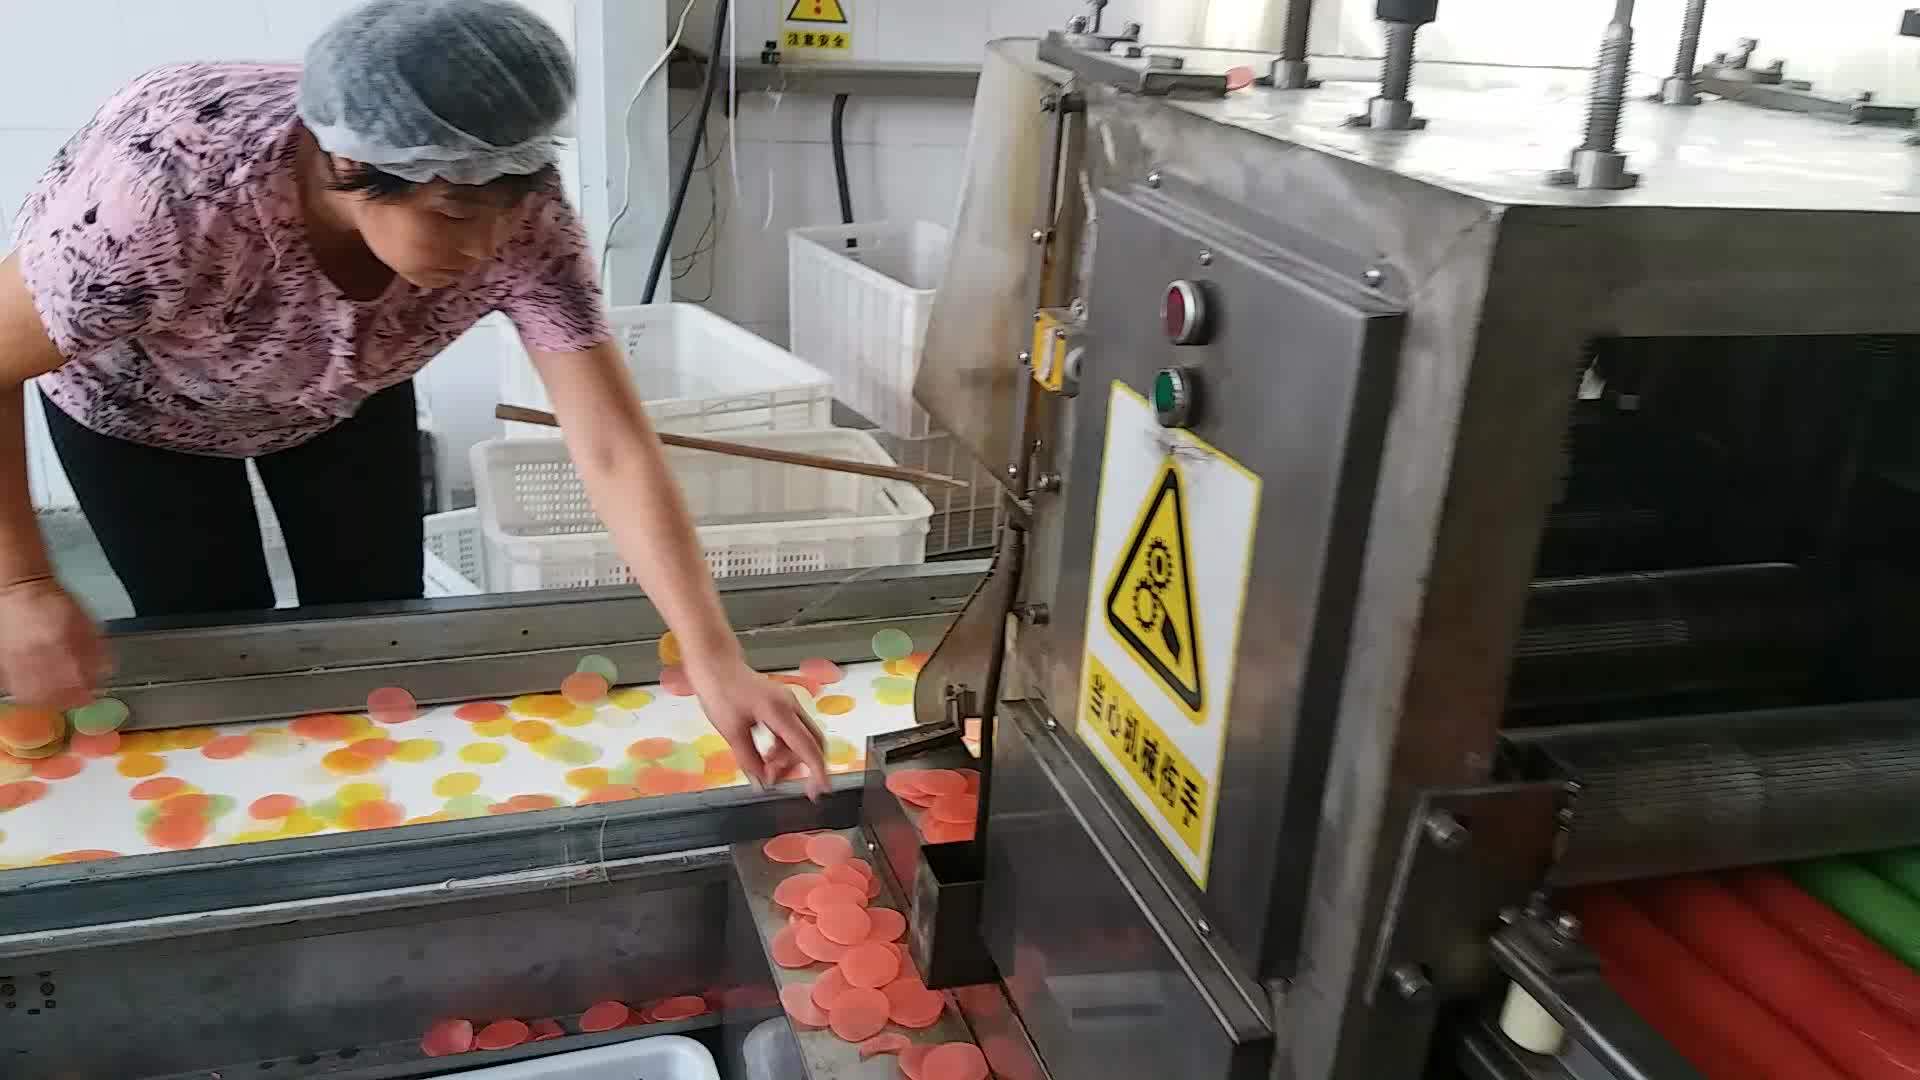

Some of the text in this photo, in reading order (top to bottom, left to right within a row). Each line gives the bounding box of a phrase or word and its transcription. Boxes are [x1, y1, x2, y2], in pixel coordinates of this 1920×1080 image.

[787, 33, 845, 47] 注意安全
[1089, 674, 1201, 828] 当心机械伤手
